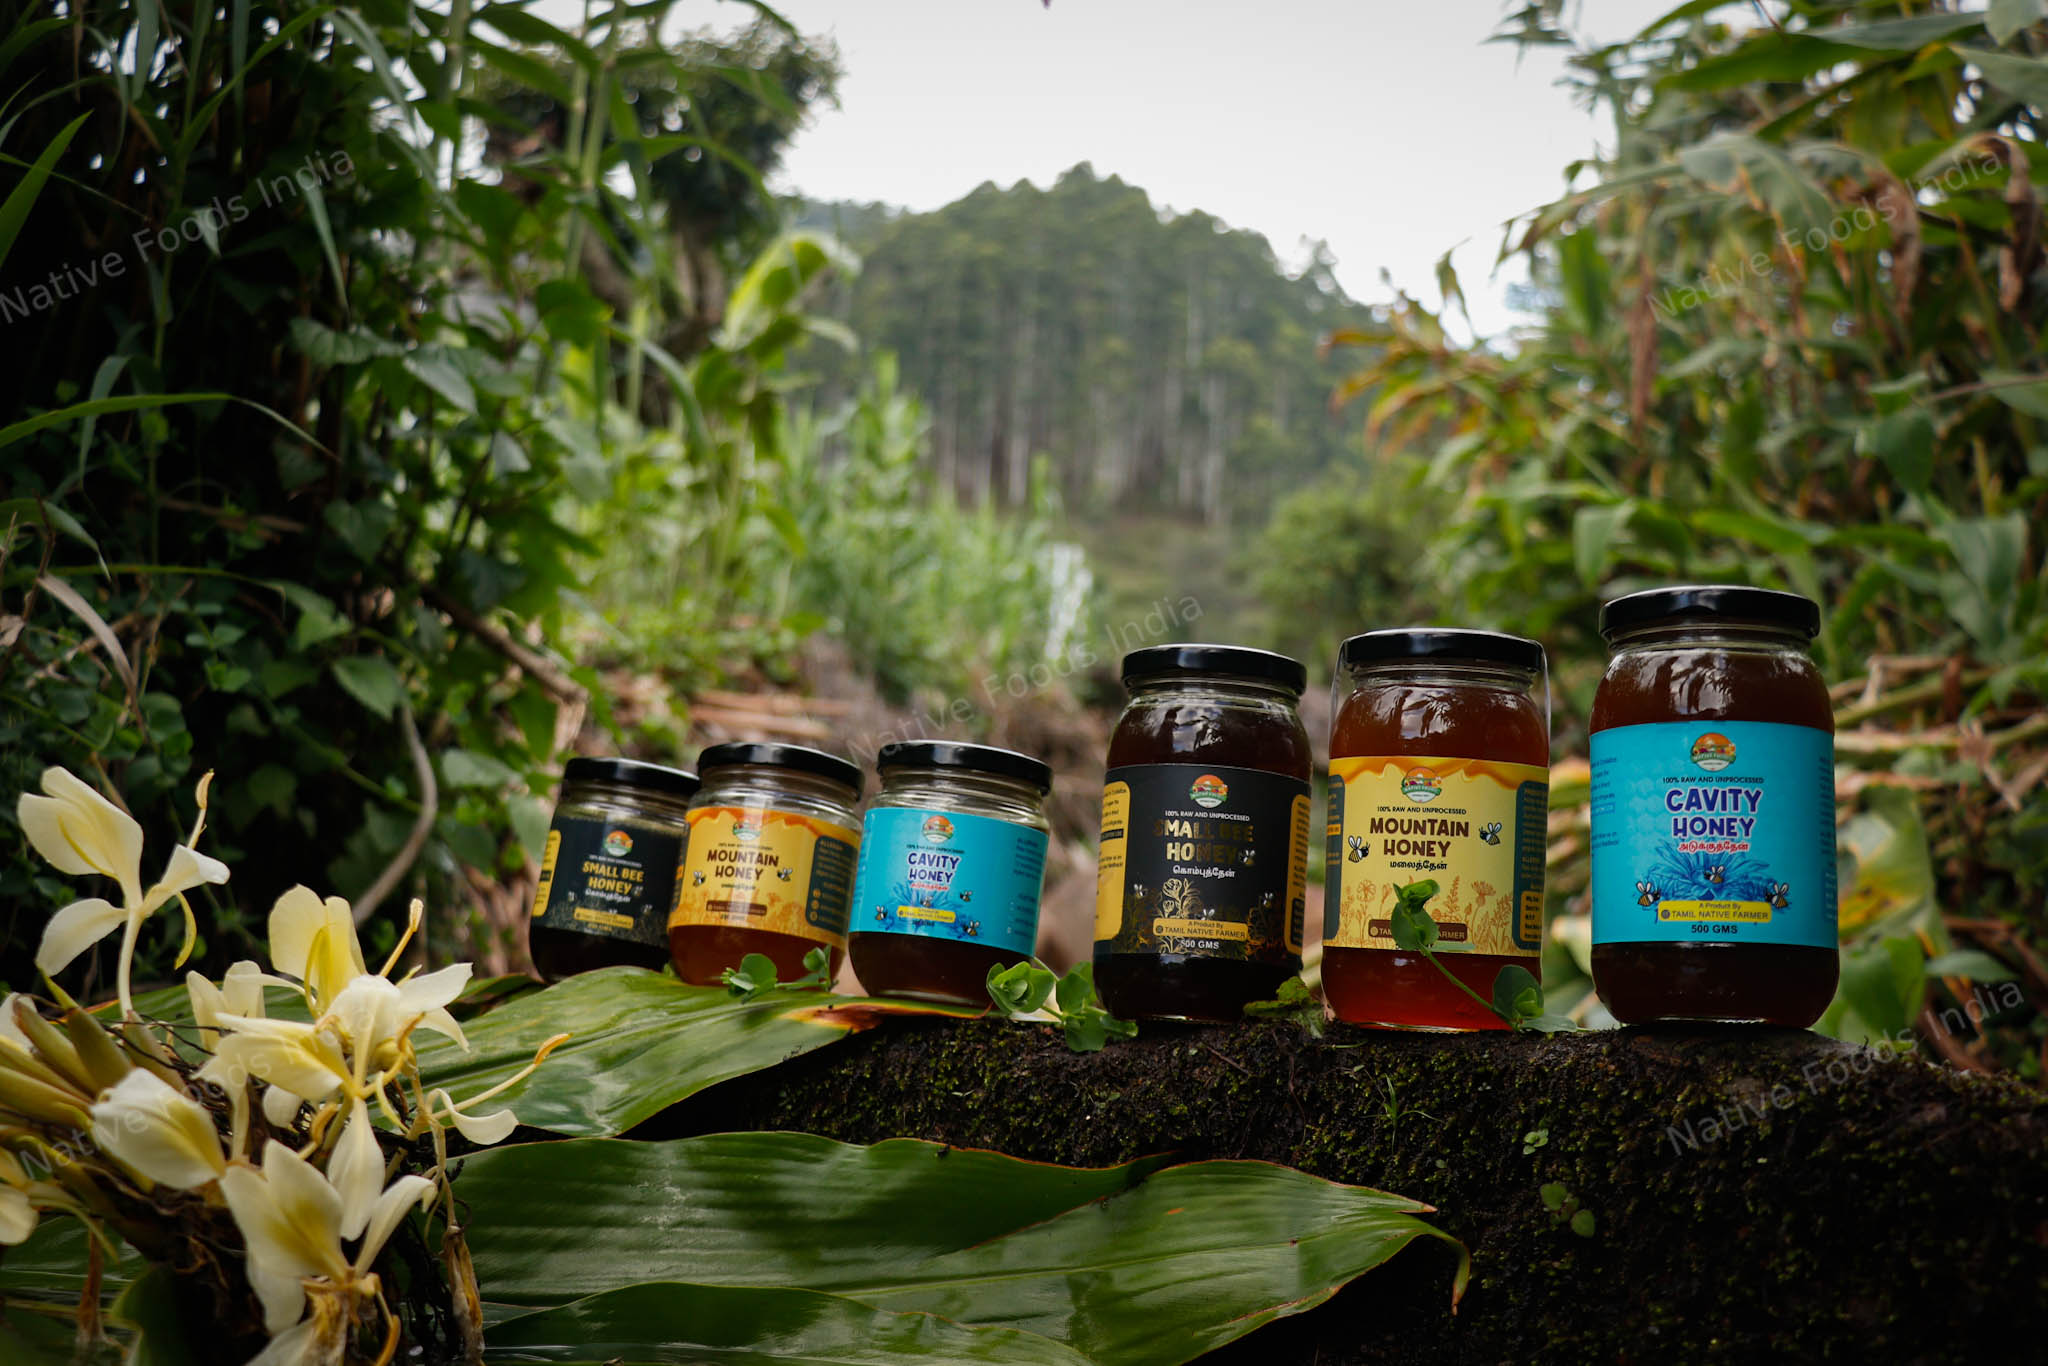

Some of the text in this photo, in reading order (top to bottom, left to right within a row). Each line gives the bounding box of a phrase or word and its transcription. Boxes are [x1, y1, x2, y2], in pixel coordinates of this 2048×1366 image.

[1666, 787, 1762, 813] CAVITY
[1209, 812, 1250, 821] UNPROCESSED
[1422, 807, 1467, 815] UNPROCESSED
[1370, 817, 1469, 837] MOUNTAIN
[1673, 816, 1754, 837] HONEY
[1166, 842, 1239, 865] HONEY
[1383, 839, 1451, 857] HONEY
[707, 849, 780, 867] MOUNTAIN
[908, 852, 961, 870] CAVITY
[582, 860, 619, 879] SMALL
[621, 867, 644, 883] BEE
[715, 865, 765, 881] HONEY
[909, 868, 954, 883] HONEY
[588, 876, 633, 896] HONEY
[1672, 910, 1769, 920] TAMIL NATIVE FARMER
[1164, 926, 1246, 938] TAMIL NATIVE FARMER
[1438, 930, 1465, 939] ARMER
[1691, 924, 1738, 934] 500 GMS
[1180, 939, 1220, 950] 500 GMS
